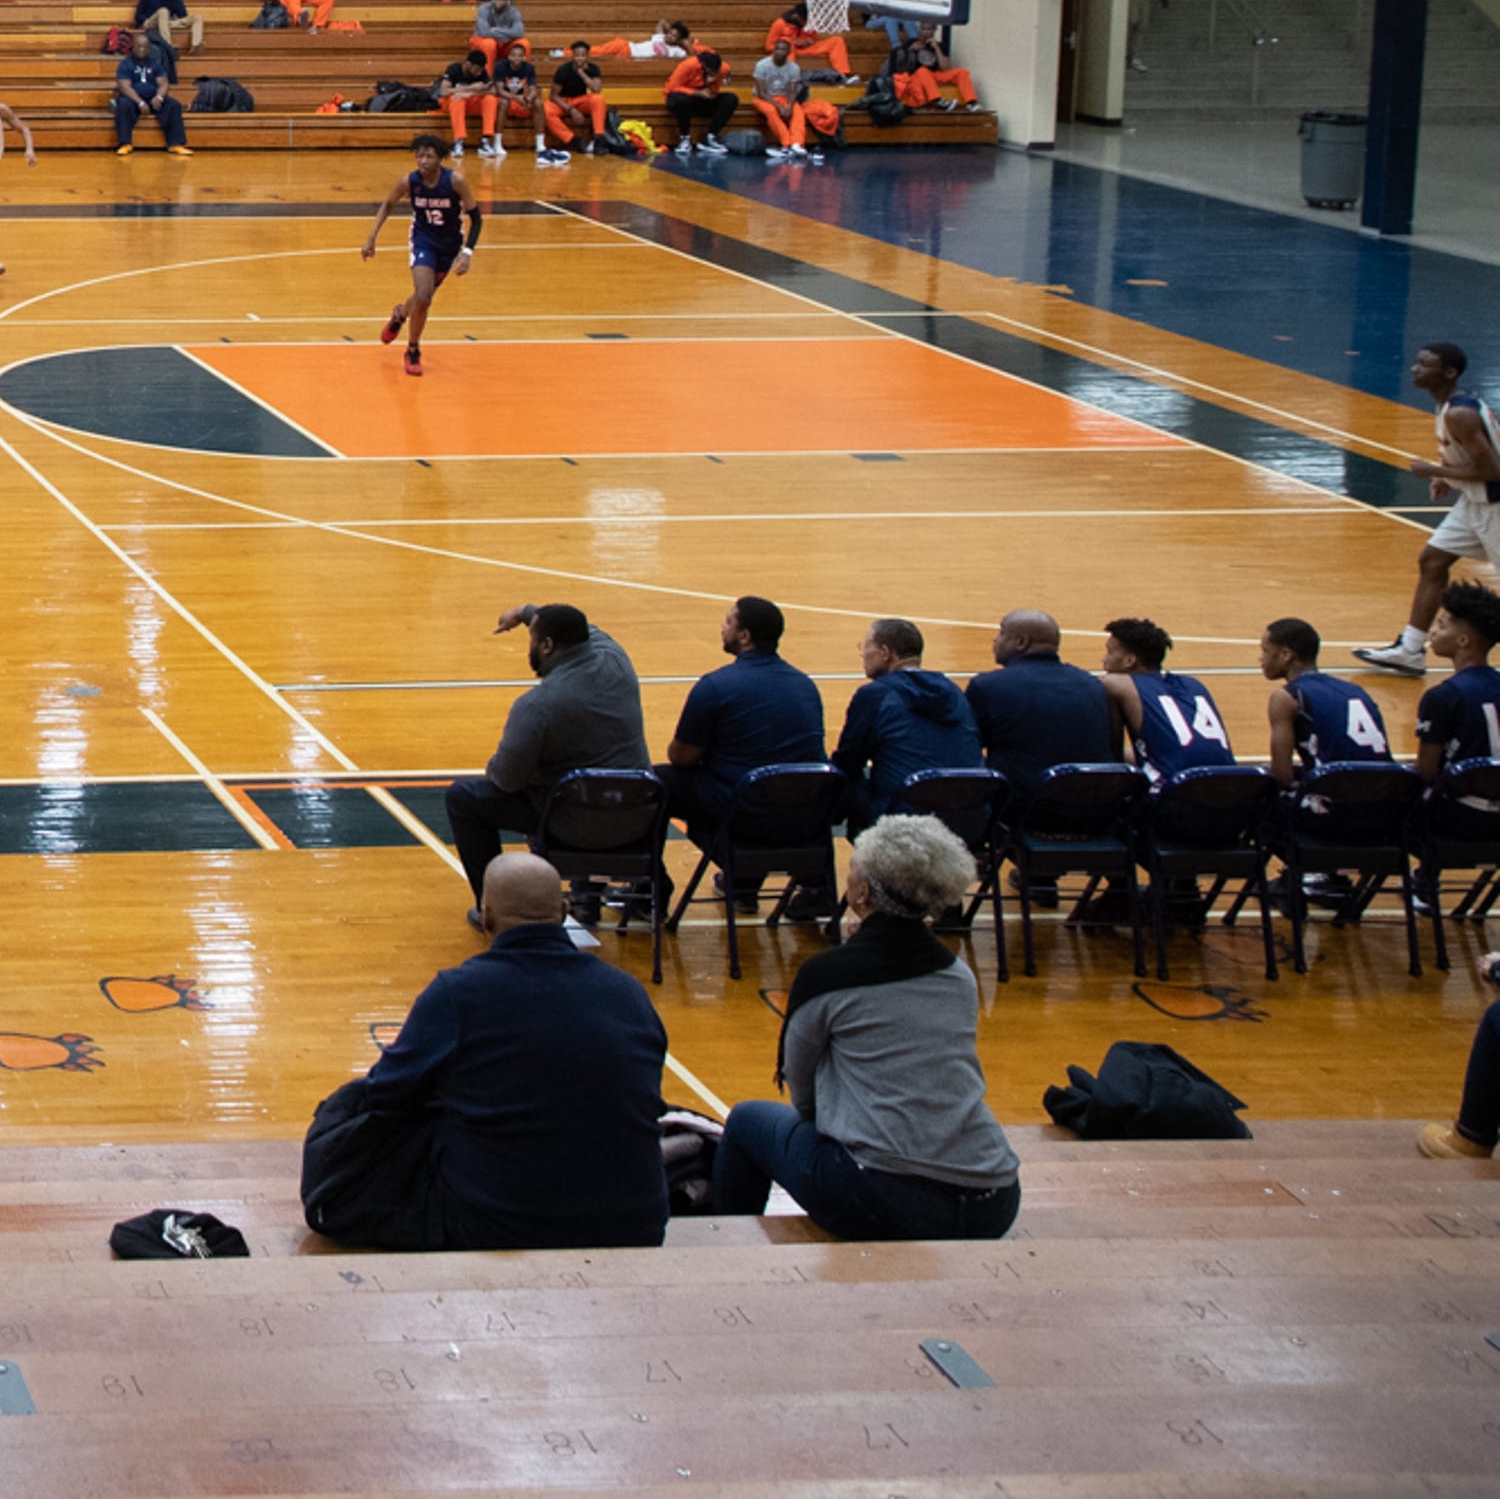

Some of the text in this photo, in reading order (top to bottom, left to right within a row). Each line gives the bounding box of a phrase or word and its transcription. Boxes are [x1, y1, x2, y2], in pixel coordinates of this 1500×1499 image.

[425, 209, 444, 226] 12
[1158, 694, 1229, 750] 14
[1346, 698, 1387, 754] 4
